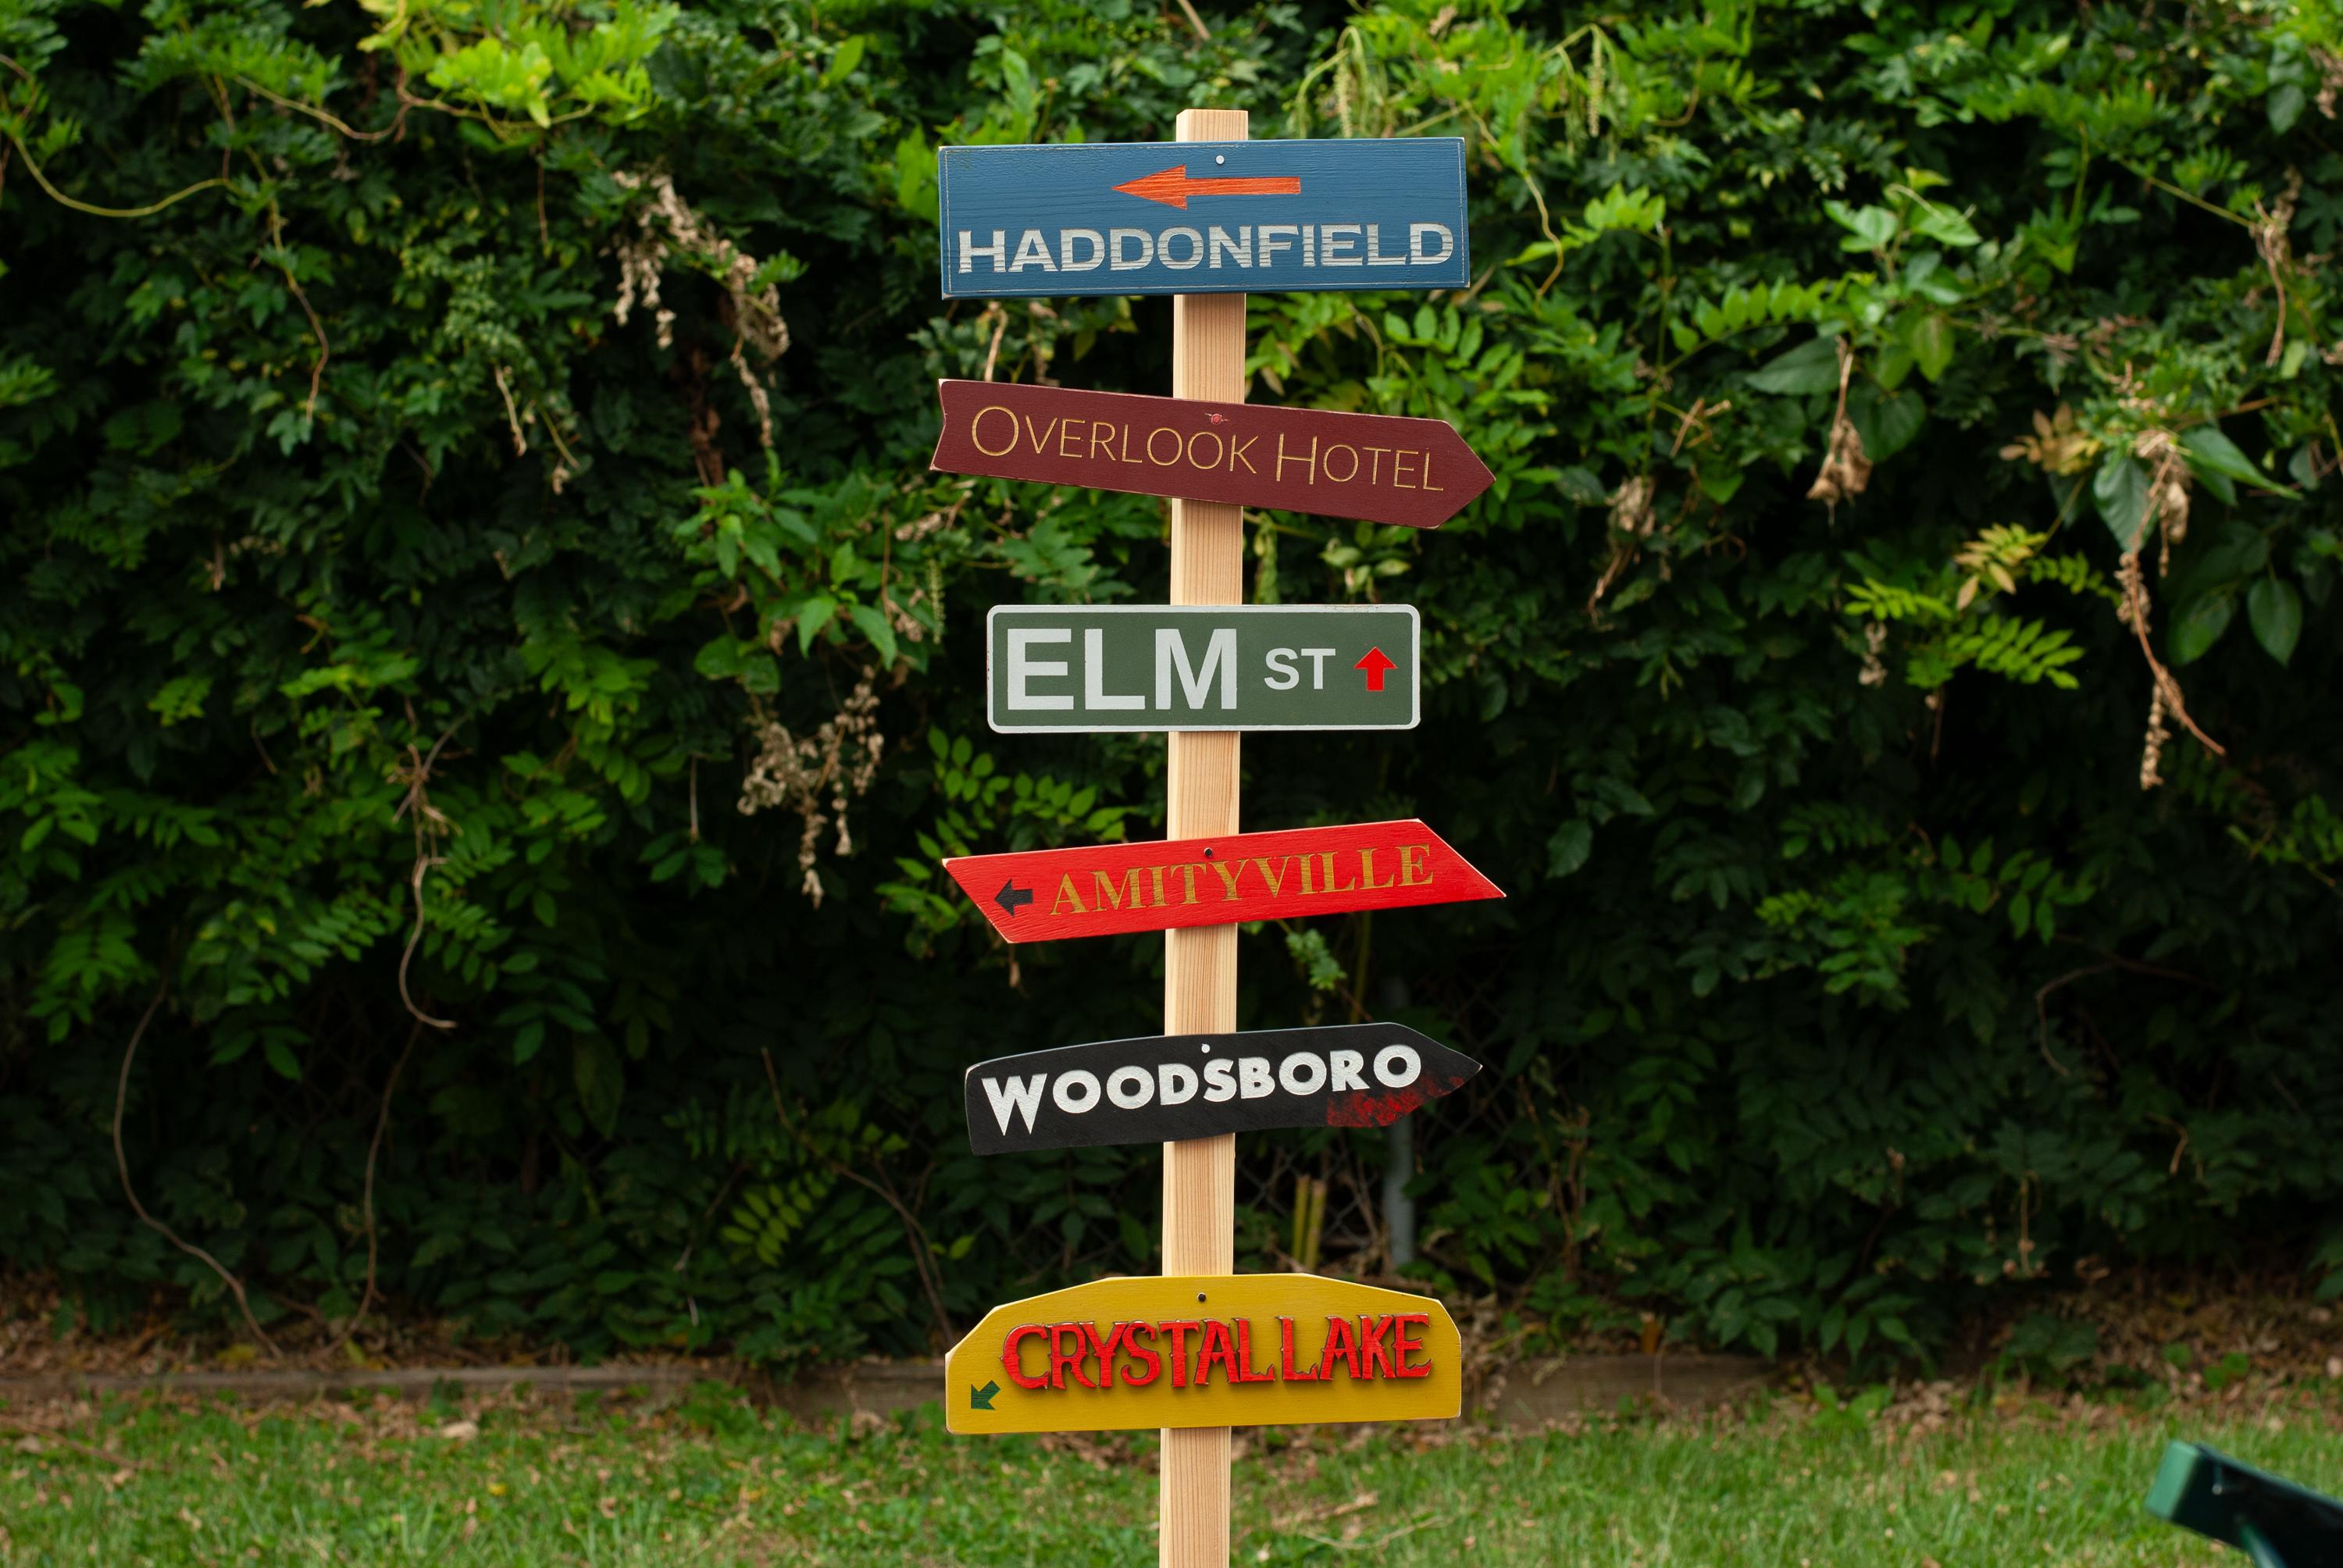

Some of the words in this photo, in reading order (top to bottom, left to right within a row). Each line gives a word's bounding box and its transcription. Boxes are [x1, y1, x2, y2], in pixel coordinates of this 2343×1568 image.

[958, 223, 1454, 273] HADDONFIELD
[971, 405, 1257, 475] OVERLOOK
[1276, 433, 1444, 492] HOTEL
[1007, 628, 1238, 711] ELM
[1264, 647, 1336, 691] ST
[1050, 843, 1434, 917] AMITYVILLE
[981, 1044, 1422, 1137] WOODSBORO
[1000, 1317, 1275, 1390] CRYSTAL
[1275, 1312, 1432, 1381] LAKE
